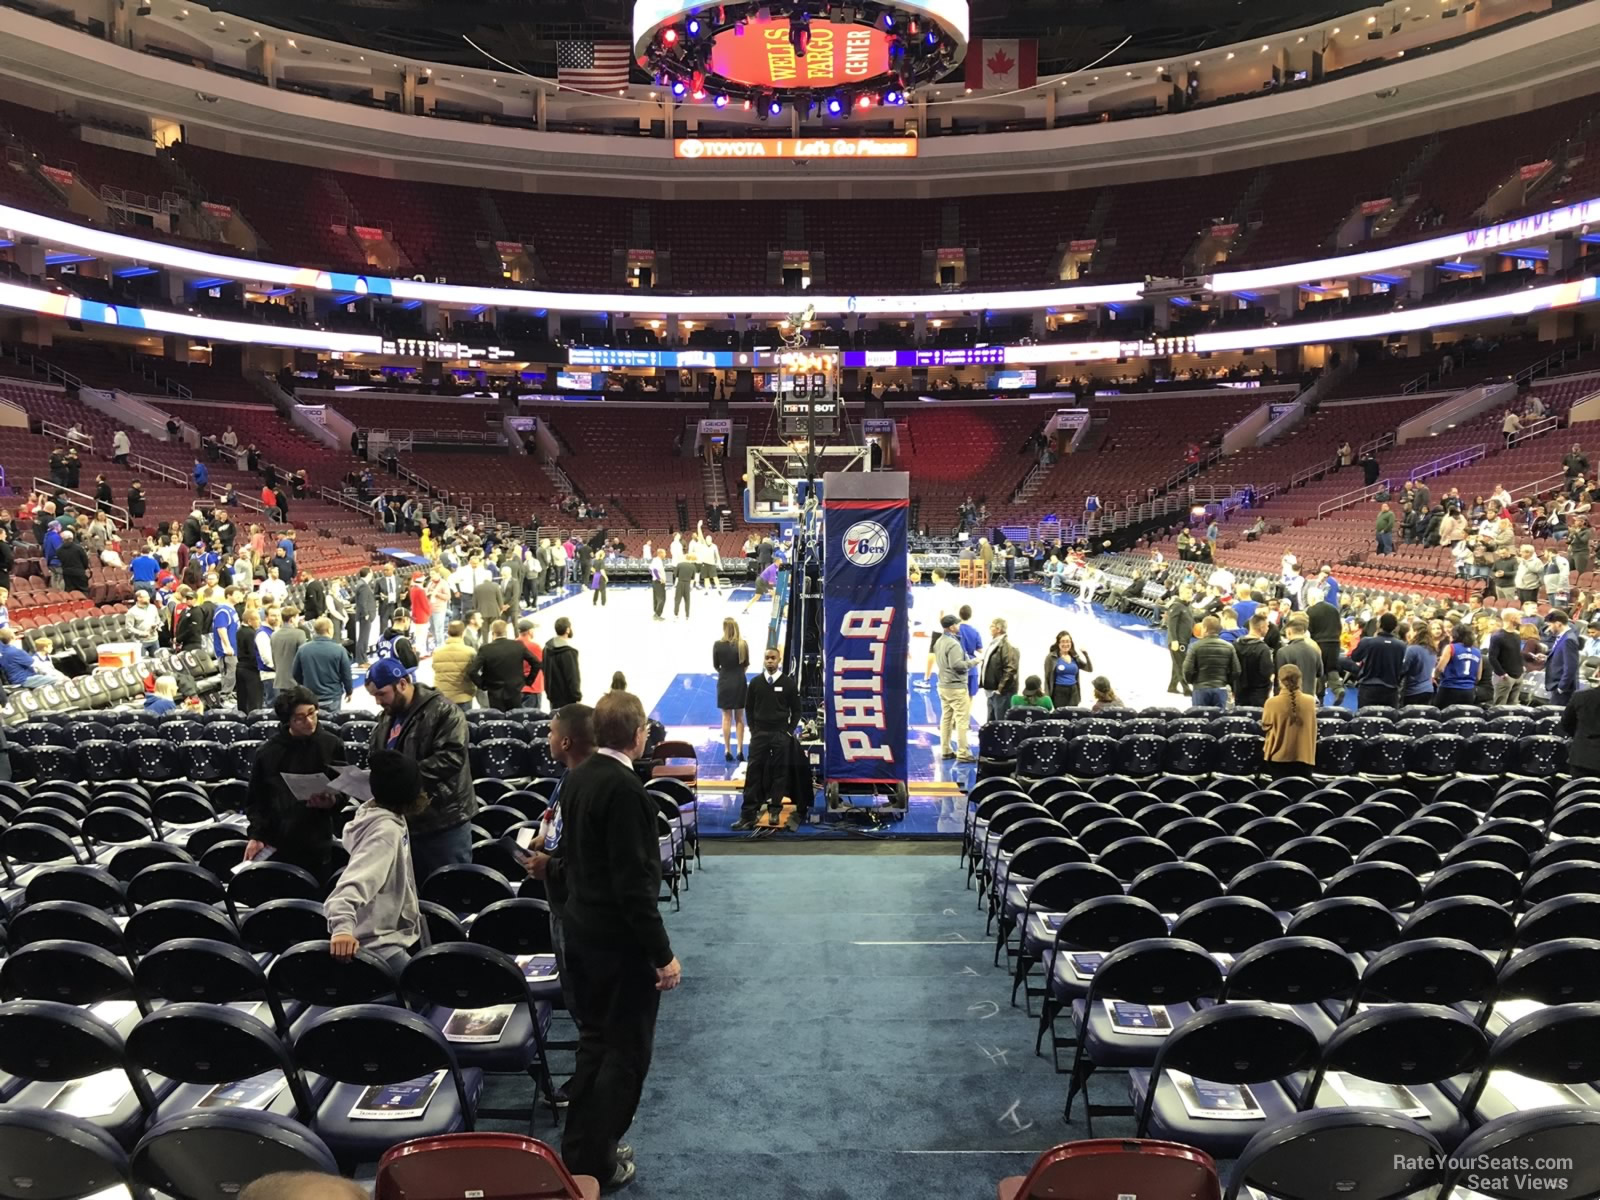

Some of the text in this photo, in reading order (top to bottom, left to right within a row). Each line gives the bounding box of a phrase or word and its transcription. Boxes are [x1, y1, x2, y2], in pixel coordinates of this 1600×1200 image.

[764, 28, 796, 81] WELLS
[806, 28, 833, 79] FARGO
[845, 30, 871, 75] CENTER
[704, 142, 765, 156] TOYOTA
[847, 538, 885, 555] 76ers
[833, 606, 895, 763] PHILA
